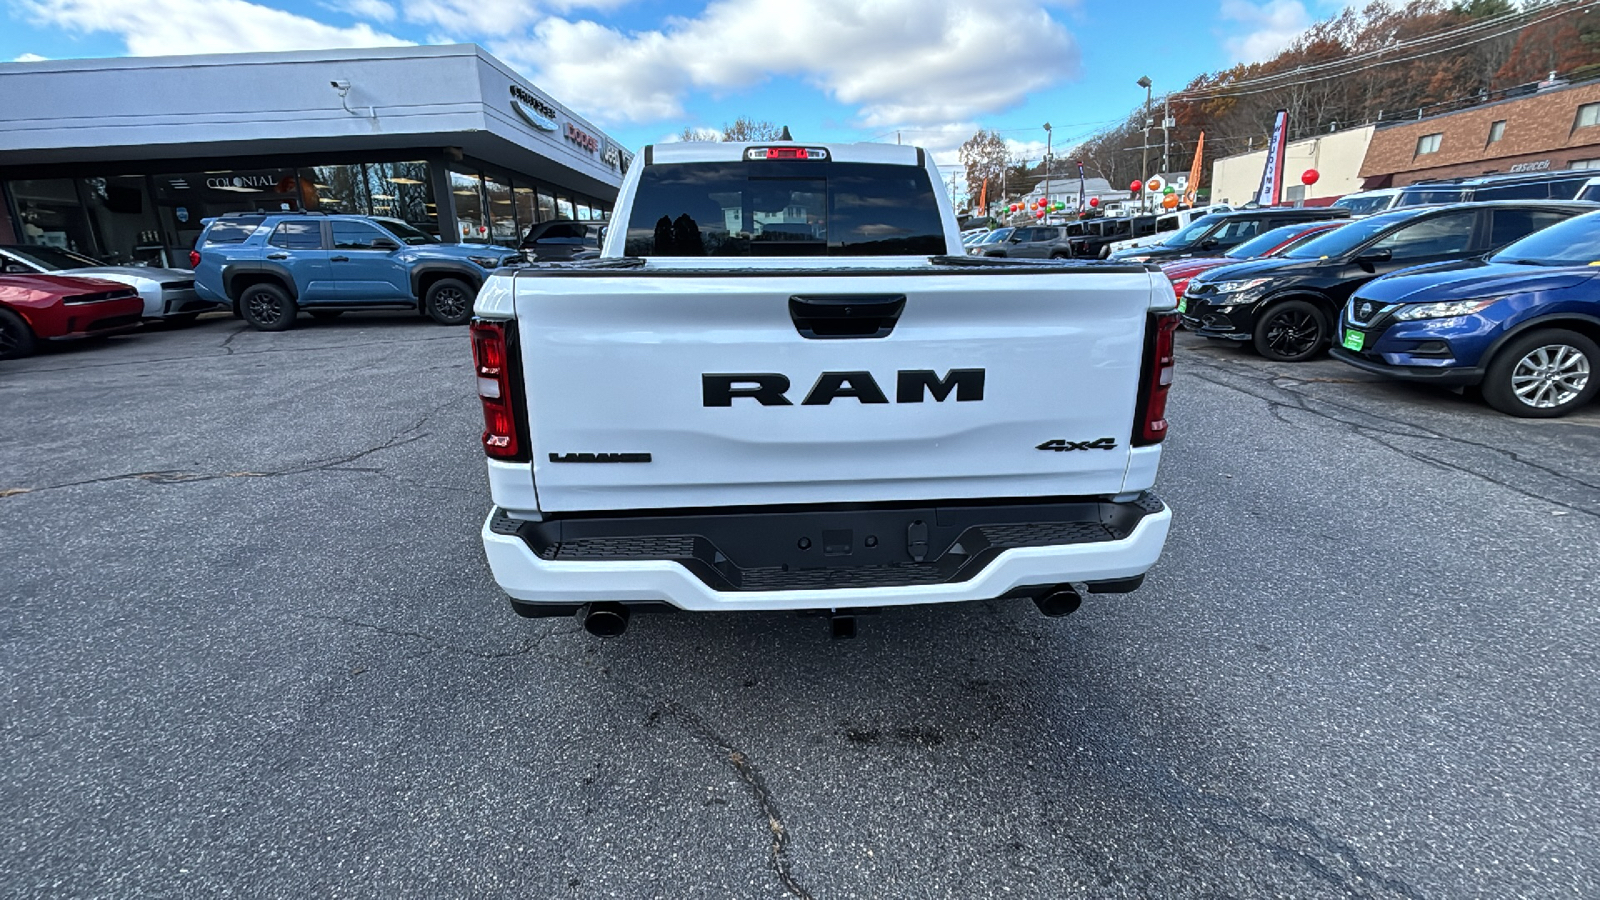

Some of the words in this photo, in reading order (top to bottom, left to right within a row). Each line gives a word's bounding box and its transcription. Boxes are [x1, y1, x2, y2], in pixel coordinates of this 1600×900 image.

[563, 122, 599, 154] DODGE
[206, 175, 279, 189] COLONIAL
[702, 368, 986, 407] RAM
[1035, 437, 1118, 452] 4x4
[549, 453, 652, 463] LARAM
